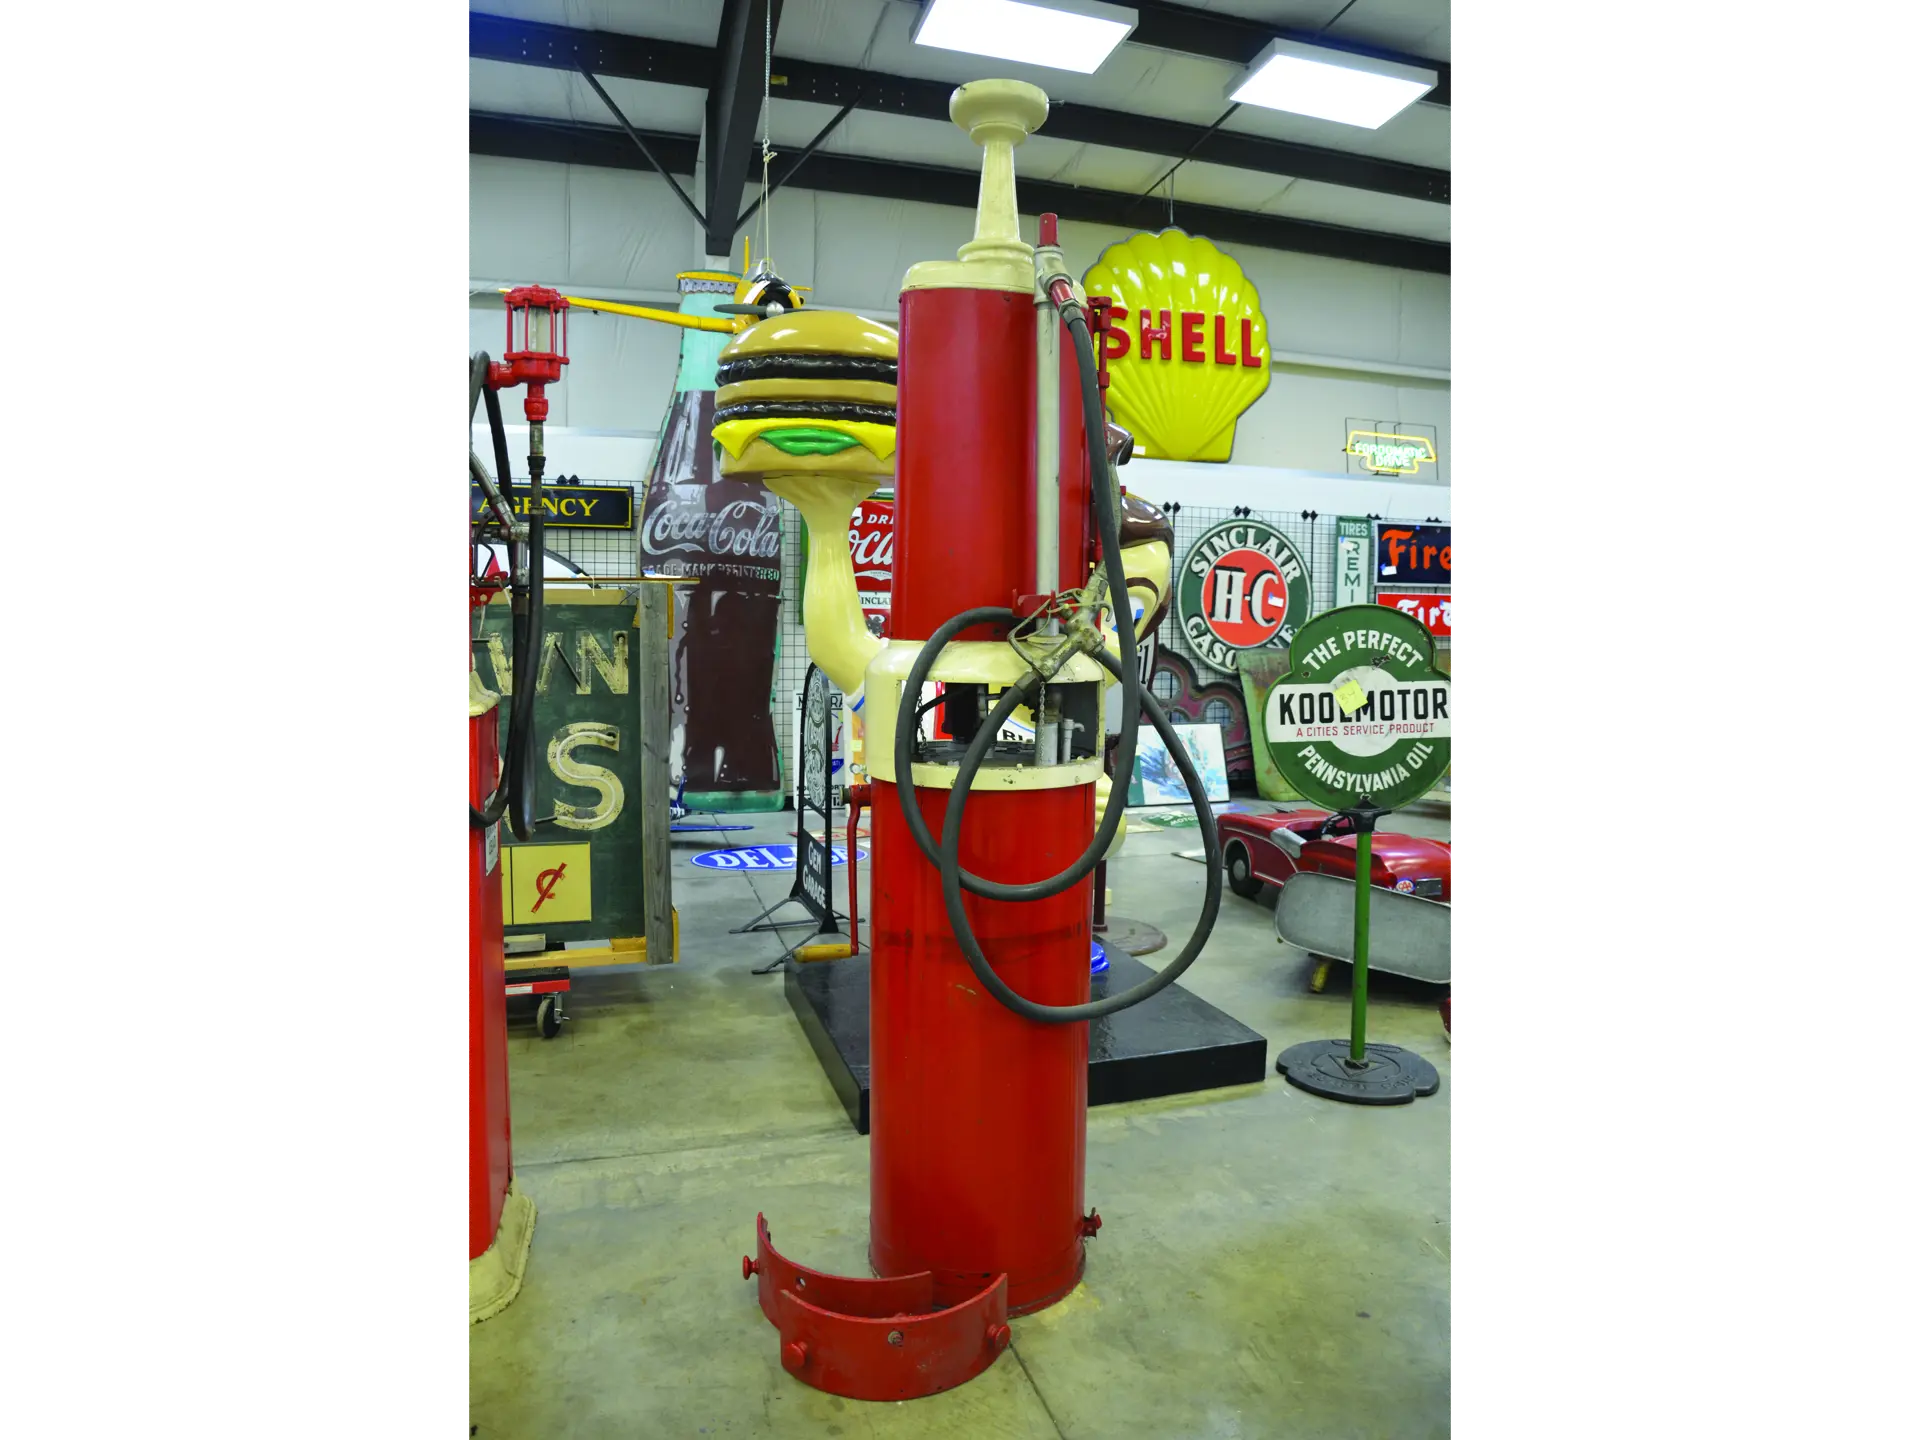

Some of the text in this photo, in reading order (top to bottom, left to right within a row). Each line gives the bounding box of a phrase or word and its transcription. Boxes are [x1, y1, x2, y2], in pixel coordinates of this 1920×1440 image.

[1104, 306, 1262, 368] SHELL
[642, 500, 780, 557] Coca-Cola
[867, 514, 893, 524] DRI
[1340, 523, 1369, 537] TIRES
[1191, 527, 1301, 584] SINCLAIR
[1209, 565, 1279, 628] H-C
[1302, 629, 1424, 671] THE PERFECT
[1296, 722, 1435, 737] A CITIES SERVICE PRODUCT
[1297, 741, 1434, 793] PENNSYLVANIA OIL
